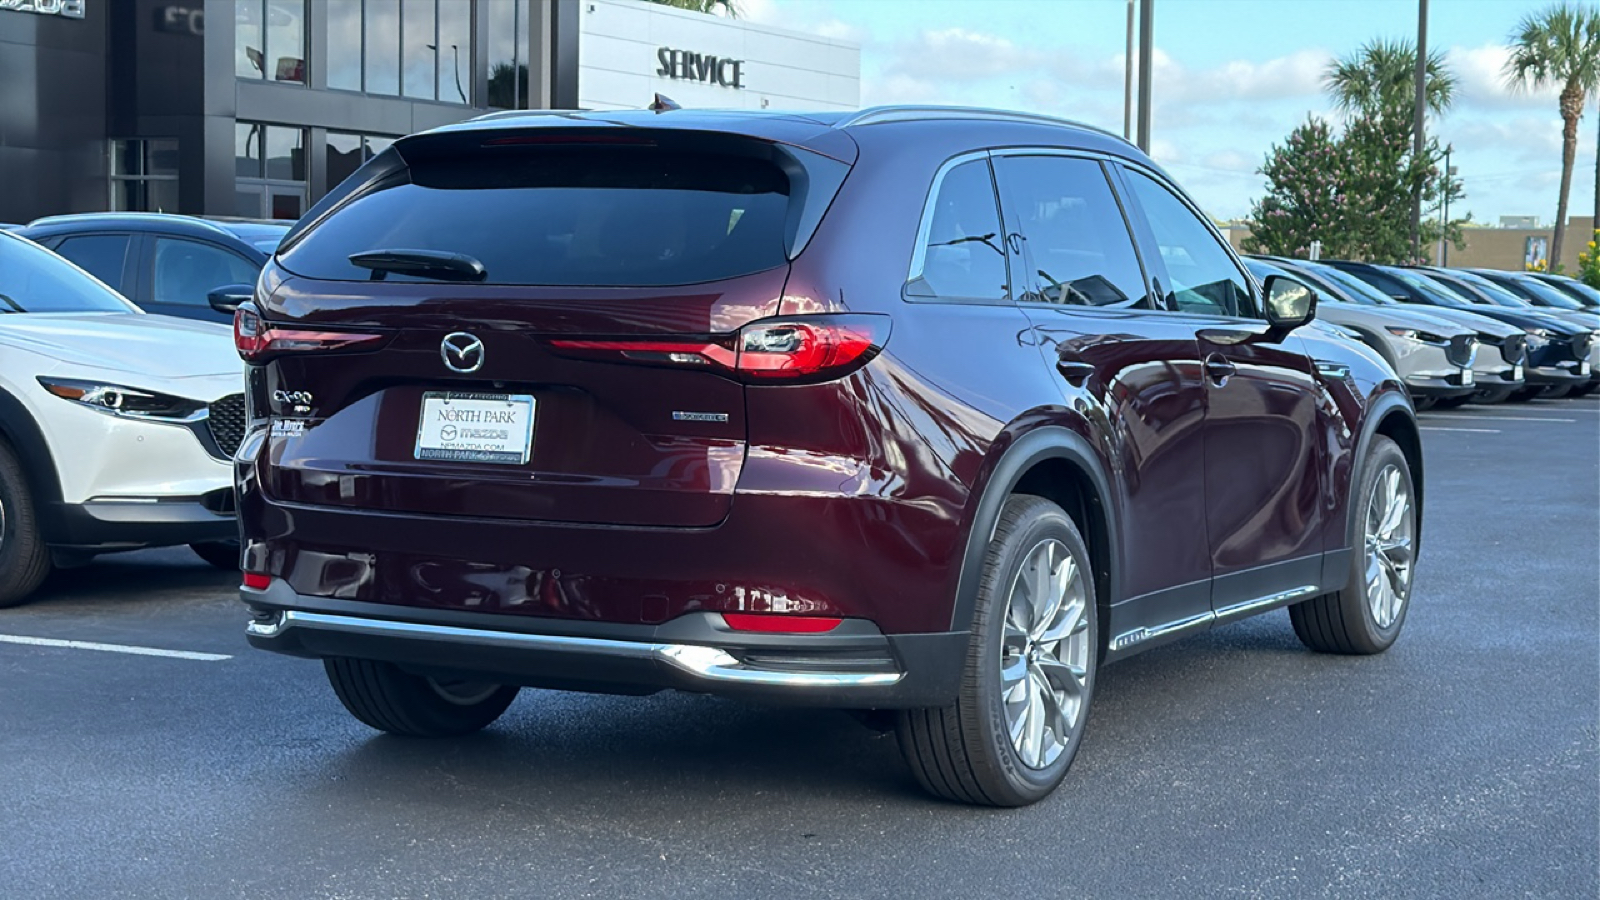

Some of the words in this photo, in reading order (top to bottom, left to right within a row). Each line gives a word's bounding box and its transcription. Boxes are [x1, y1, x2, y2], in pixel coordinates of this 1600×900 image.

[656, 46, 745, 90] SERVICE
[438, 408, 481, 422] NORTH
[484, 411, 516, 423] PARK
[460, 428, 508, 439] mazda
[441, 442, 504, 450] NPMAZDACOM
